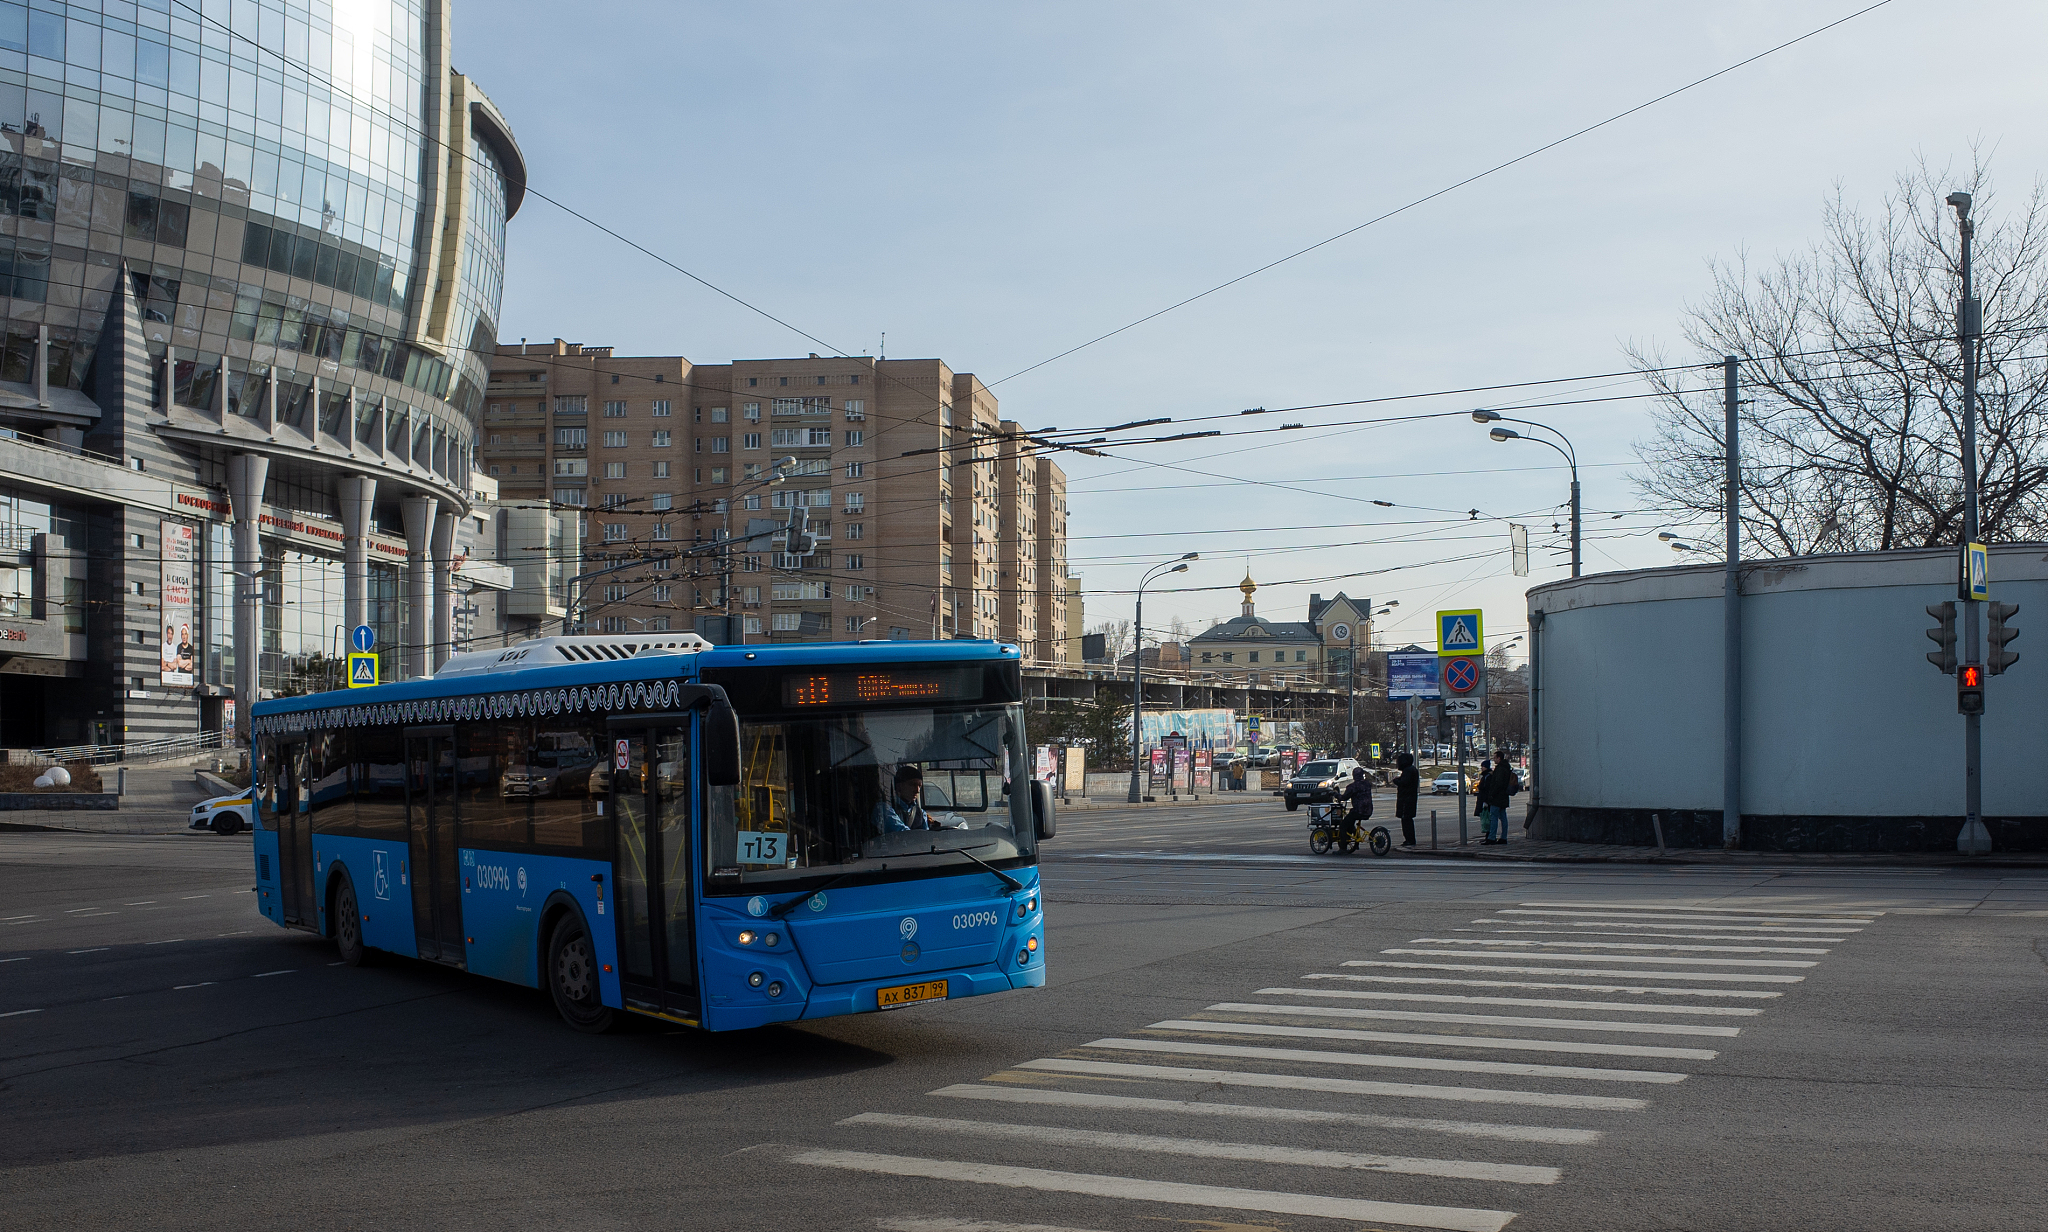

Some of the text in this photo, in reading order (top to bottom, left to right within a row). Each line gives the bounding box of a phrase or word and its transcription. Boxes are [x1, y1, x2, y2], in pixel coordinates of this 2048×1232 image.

[178, 493, 232, 515] МОСКОВСКИЙ
[259, 513, 305, 533] АРСТВЕННЫЙ
[305, 524, 346, 543] МУЗЫКАЛЬН
[376, 541, 410, 558] ФОЛЬКЛОР
[172, 575, 189, 586] СНОВА
[476, 864, 510, 891] 030996
[952, 910, 998, 930] 030996
[904, 986, 926, 1000] 837
[932, 982, 944, 992] 99
